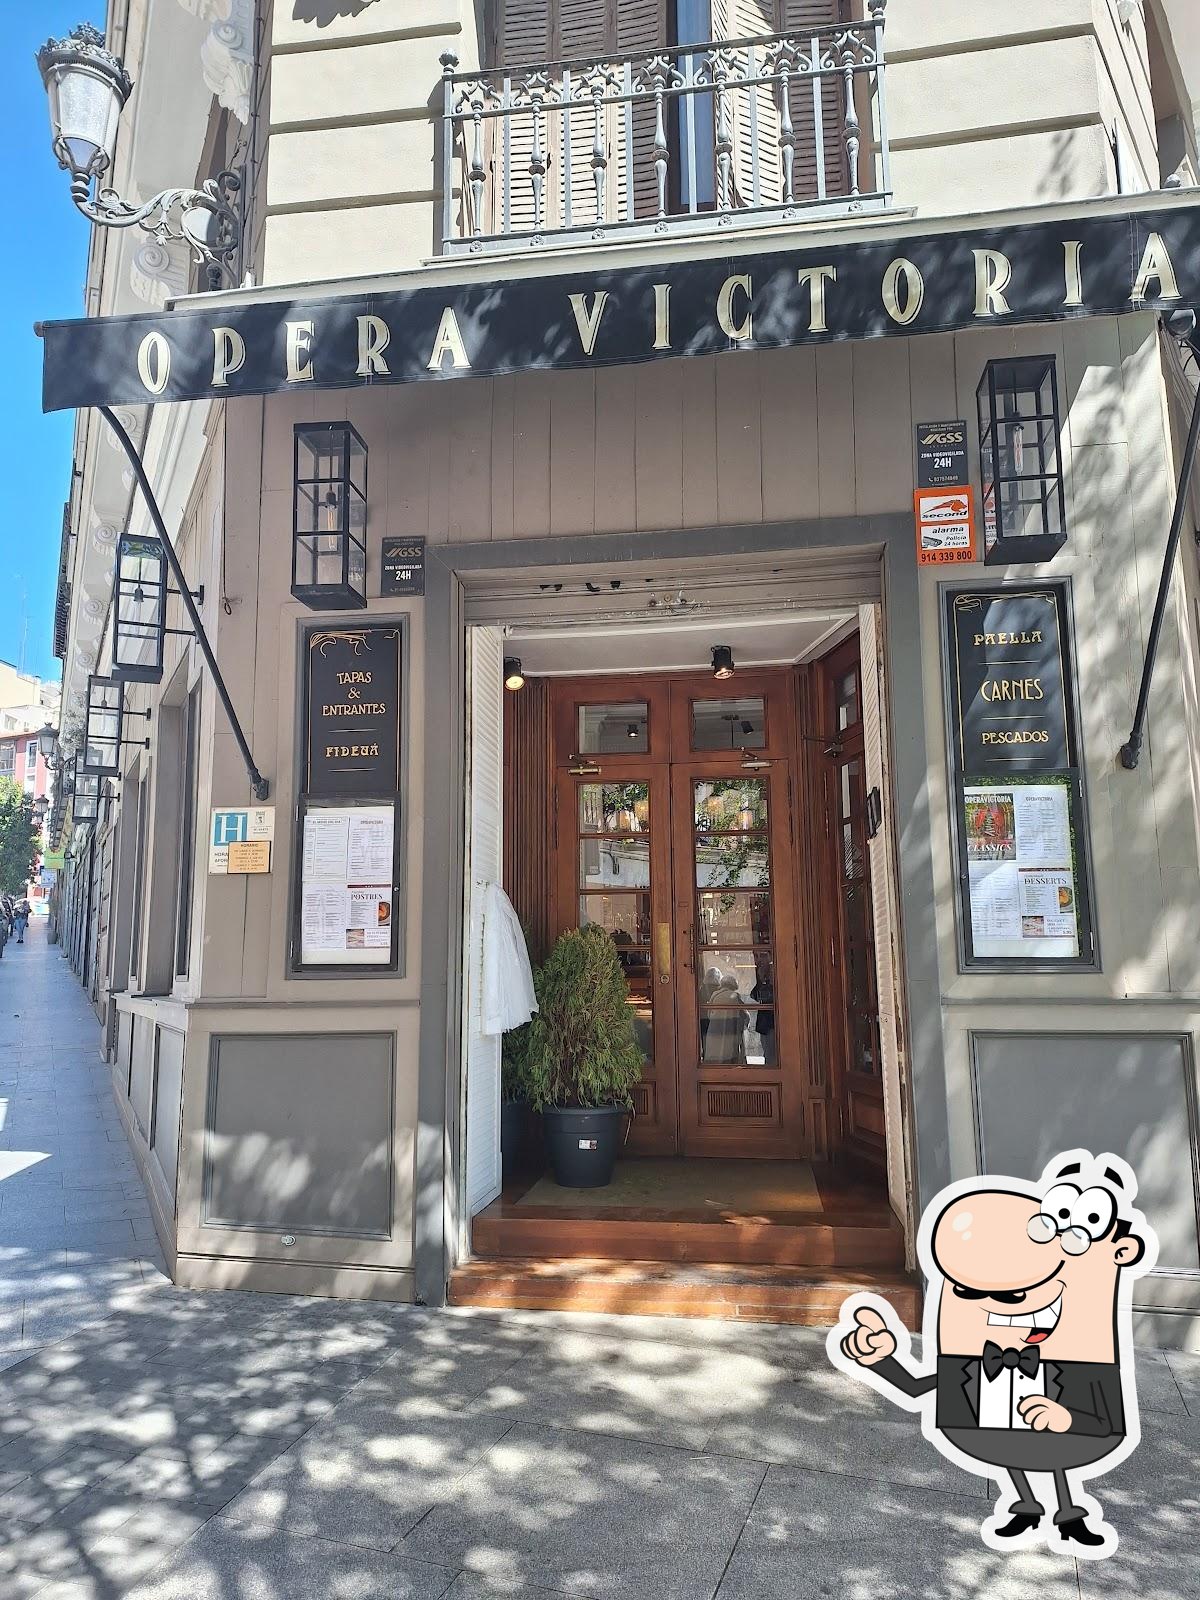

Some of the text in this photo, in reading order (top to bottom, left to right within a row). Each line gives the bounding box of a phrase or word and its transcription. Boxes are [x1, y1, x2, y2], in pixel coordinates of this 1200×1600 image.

[137, 232, 1183, 395] OPERA VICTORIA
[936, 431, 963, 444] GSS
[933, 457, 952, 469] 24H
[922, 510, 968, 519] second
[399, 547, 422, 558] GSS
[921, 550, 972, 563] 914 339 800
[395, 570, 411, 581] 24H
[973, 631, 1043, 646] PAELLA
[336, 671, 372, 684] TAPAS
[347, 687, 361, 699] &
[980, 678, 1045, 702] CARNES
[322, 703, 386, 716] ENTRANTES
[981, 730, 1049, 745] PESCADOS
[216, 814, 247, 843] H
[967, 843, 1012, 852] CLASSICS
[1024, 877, 1067, 885] DESSERTS
